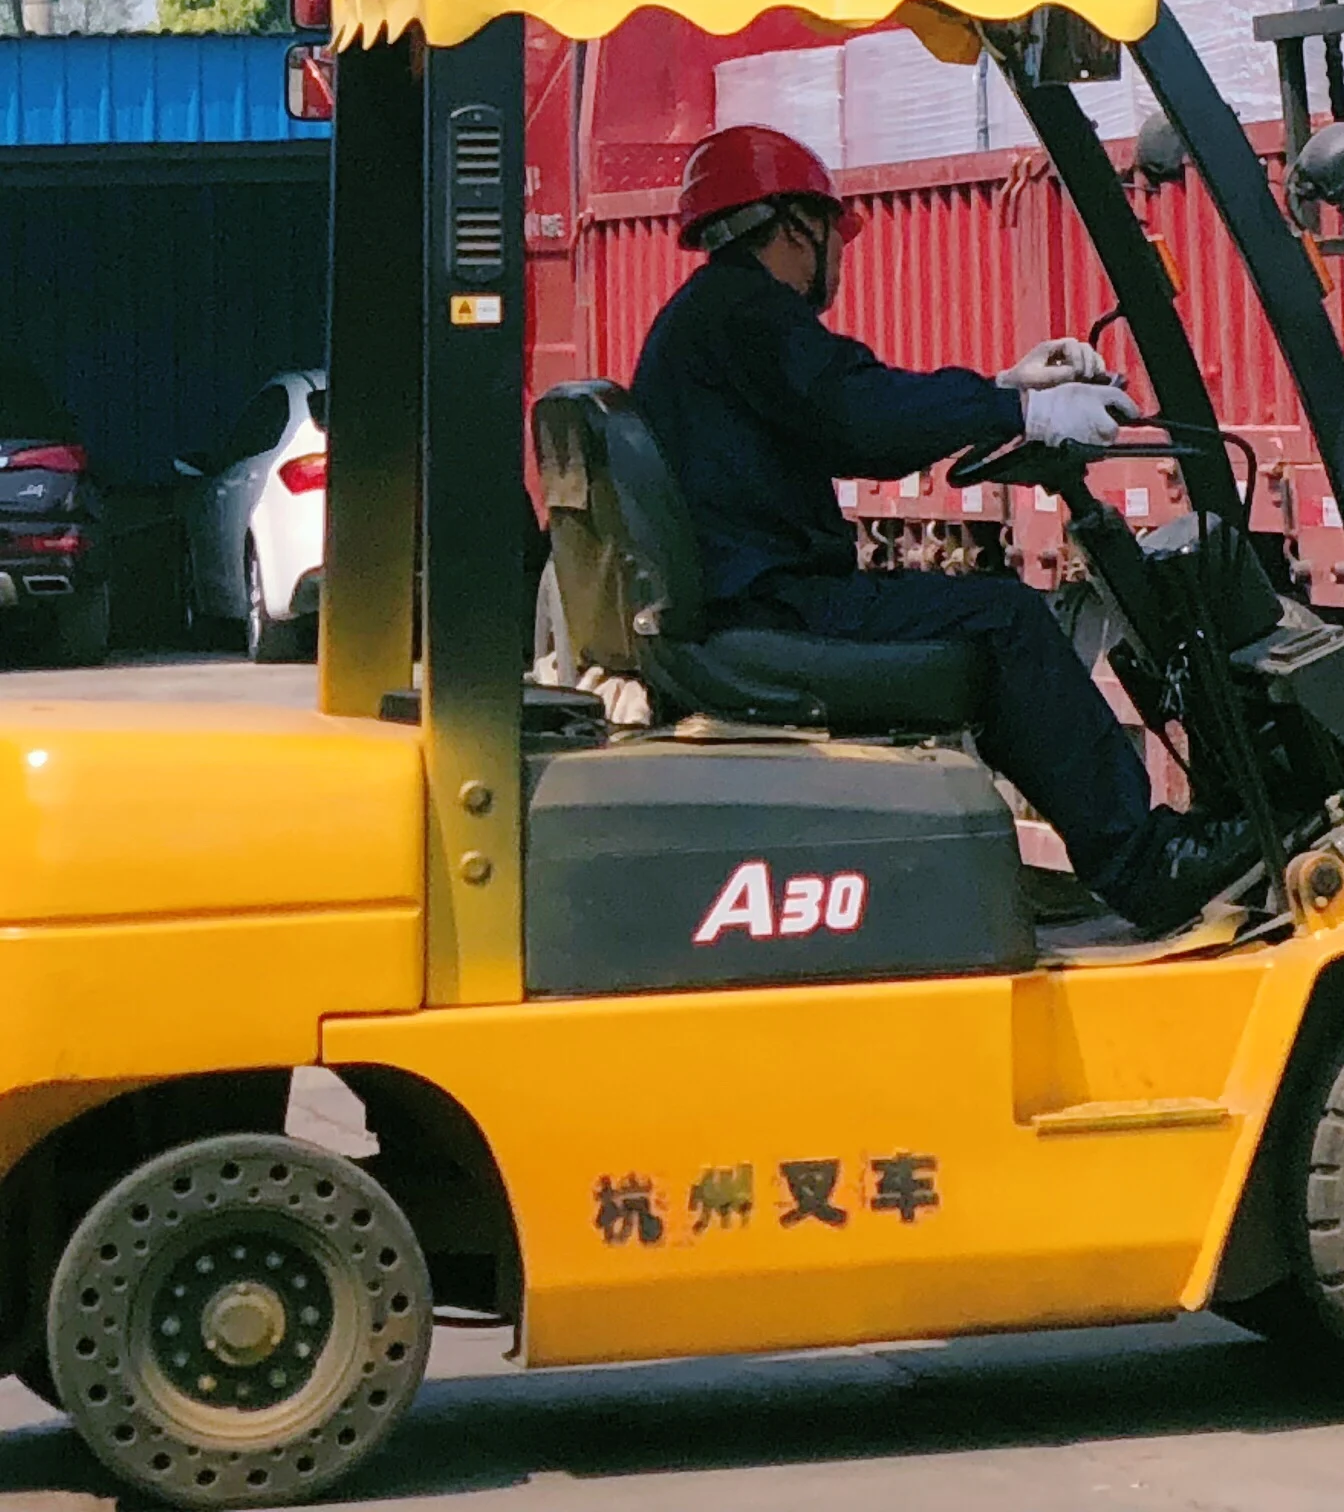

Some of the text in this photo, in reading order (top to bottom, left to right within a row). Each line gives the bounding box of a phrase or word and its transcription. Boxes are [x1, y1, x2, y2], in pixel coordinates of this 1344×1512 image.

[693, 859, 867, 945] A30
[594, 1152, 938, 1245] 杭州叉车
